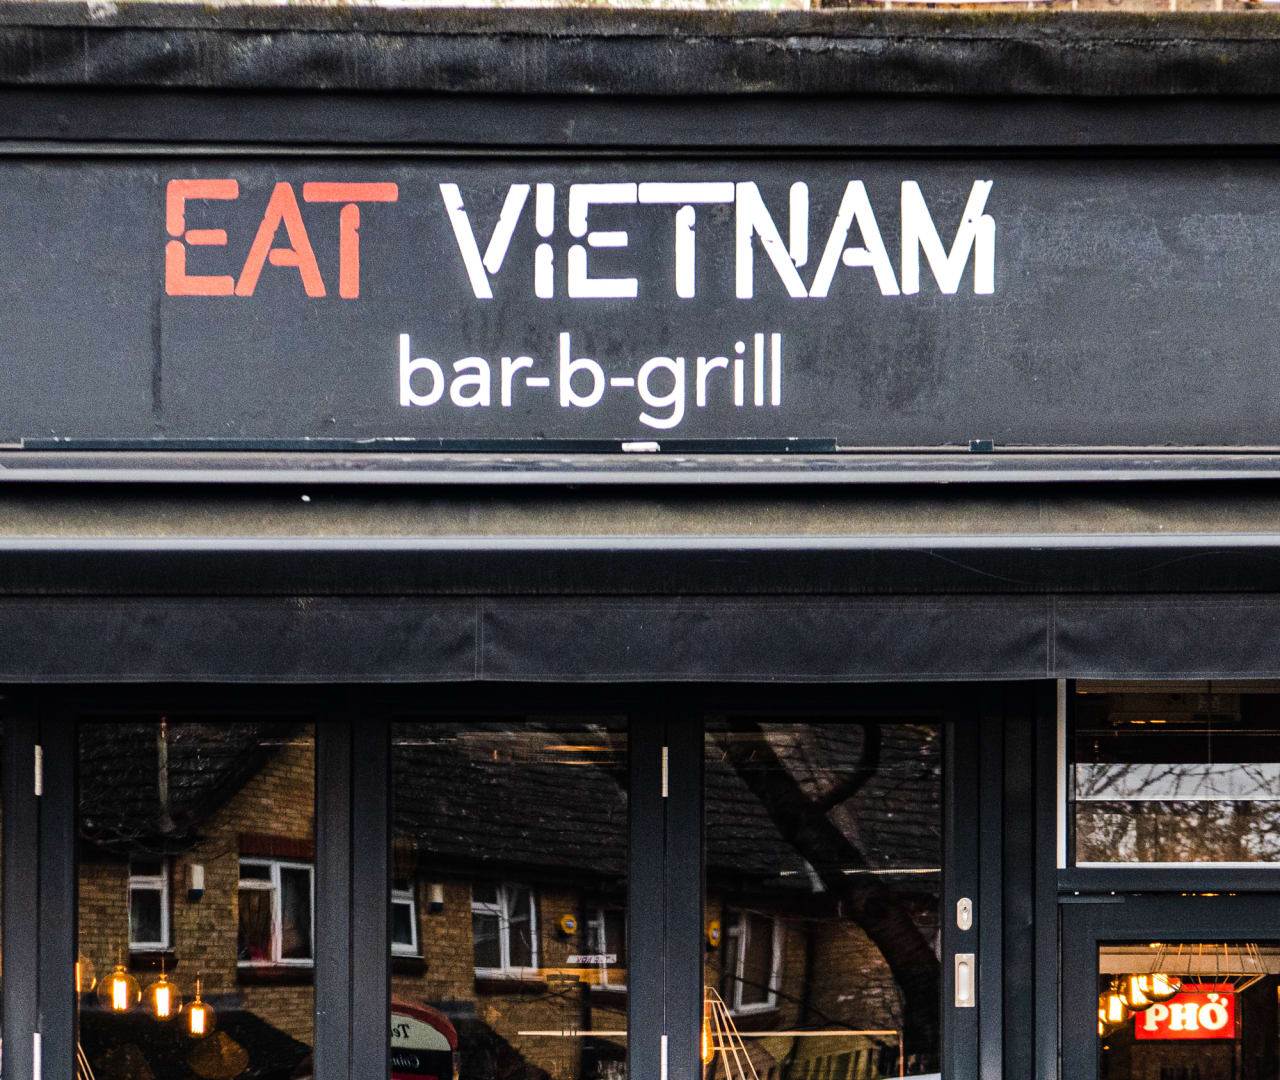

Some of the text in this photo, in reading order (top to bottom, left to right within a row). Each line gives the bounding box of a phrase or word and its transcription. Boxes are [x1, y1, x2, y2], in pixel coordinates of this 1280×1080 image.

[165, 179, 995, 299] EAT VIETNAM
[399, 331, 782, 430] bar-b-grill
